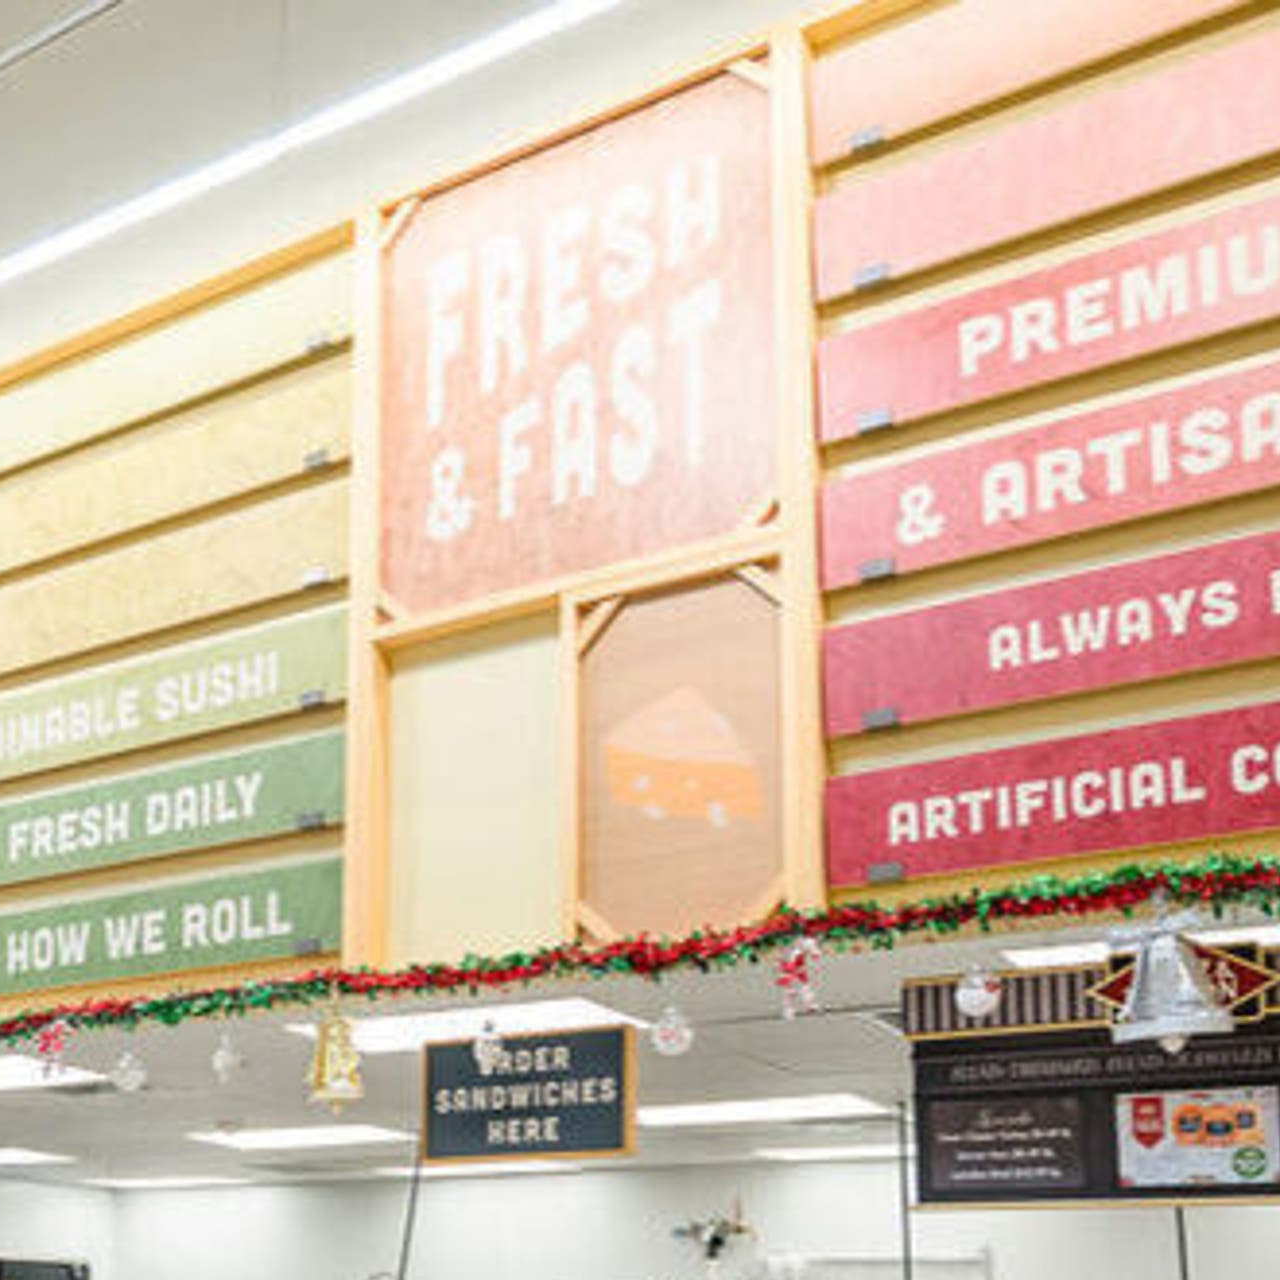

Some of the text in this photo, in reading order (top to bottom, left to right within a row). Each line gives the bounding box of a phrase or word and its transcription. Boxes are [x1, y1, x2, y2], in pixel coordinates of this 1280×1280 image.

[427, 155, 720, 429] FRESH
[425, 278, 722, 542] & FAST
[895, 484, 946, 547] &
[988, 580, 1240, 671] ALWAYS
[154, 652, 279, 713] SUSHI
[9, 802, 131, 864] FRESH
[146, 773, 263, 835] DAILY
[887, 758, 1206, 846] ARTIFICIAL
[7, 921, 90, 972] HOW
[103, 911, 166, 959] WE
[182, 891, 293, 946] ROLL
[434, 1077, 617, 1114] SANDWICHES
[488, 1117, 559, 1144] HERE
